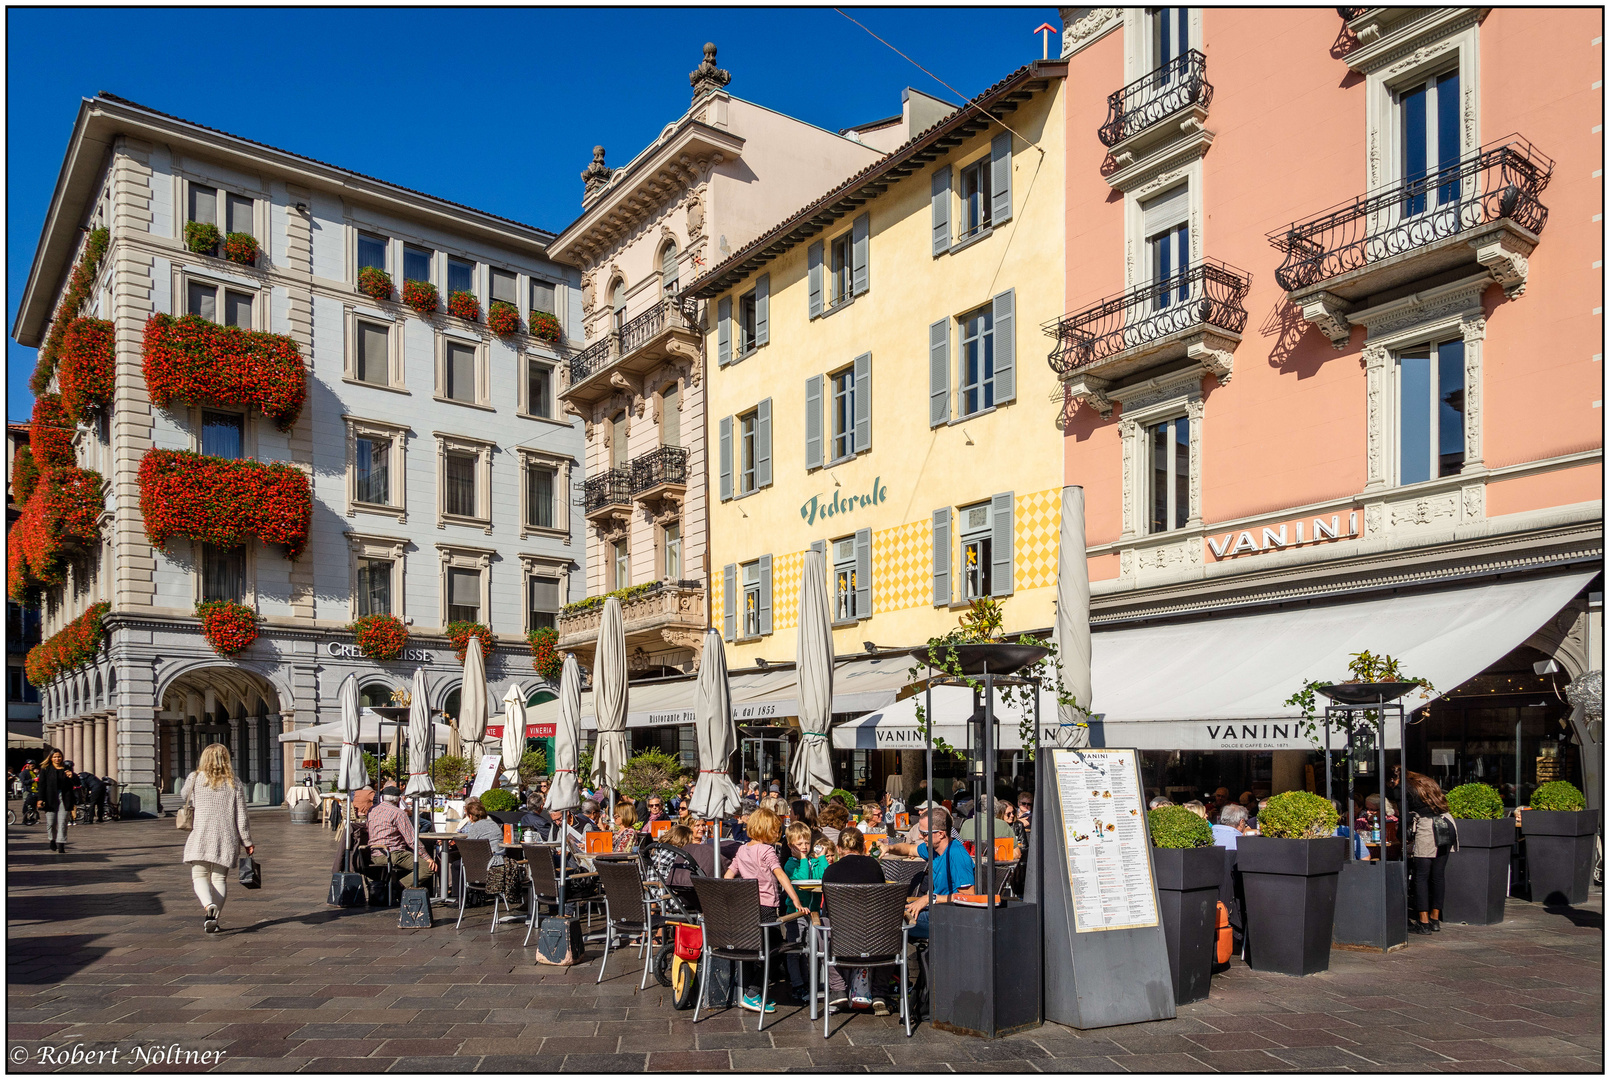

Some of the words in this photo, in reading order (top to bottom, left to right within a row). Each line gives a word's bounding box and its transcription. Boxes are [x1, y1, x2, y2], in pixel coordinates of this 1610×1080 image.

[800, 476, 887, 526] Federale
[1207, 512, 1358, 557] VANINI
[327, 642, 367, 657] CRED
[649, 713, 680, 723] Ristorante
[683, 711, 696, 721] Pizz
[743, 707, 754, 717] dal
[758, 705, 775, 716] 1855
[529, 727, 553, 735] VINERIA
[876, 730, 923, 742] VANIN
[1206, 724, 1299, 739] VANINI
